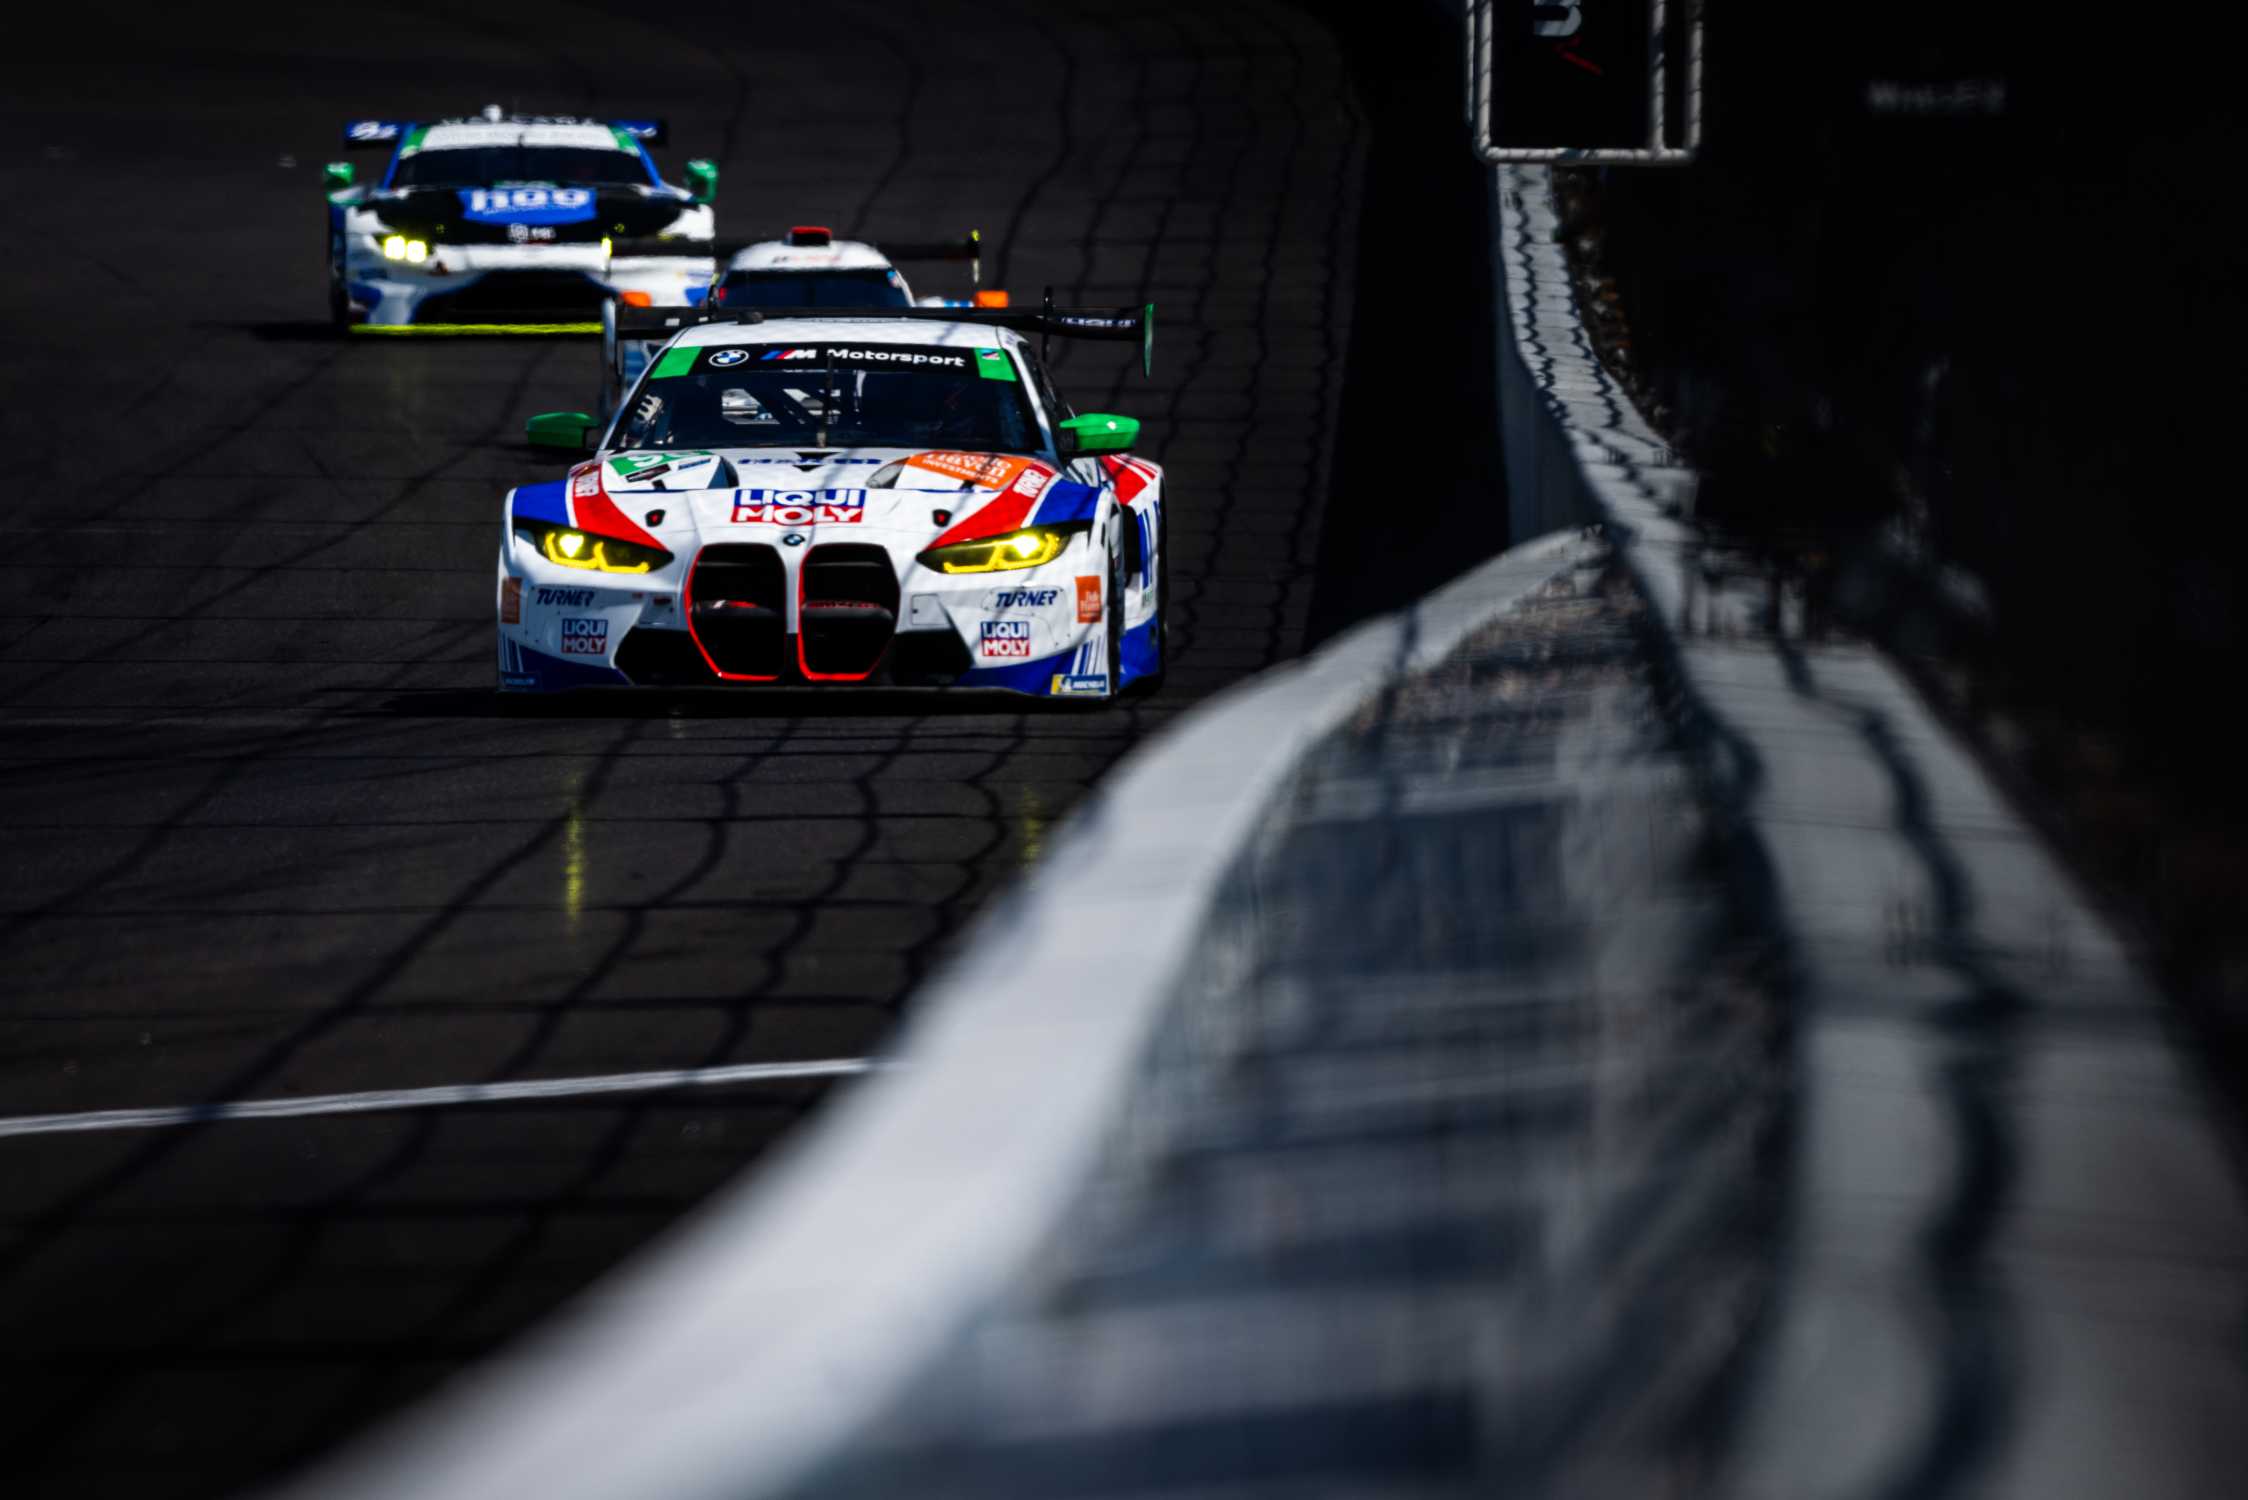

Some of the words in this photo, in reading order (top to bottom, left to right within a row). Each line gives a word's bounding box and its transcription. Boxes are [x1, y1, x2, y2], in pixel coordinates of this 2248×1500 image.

[827, 348, 966, 368] Motorsport
[739, 490, 858, 507] LIQUI
[736, 506, 862, 526] MOLY
[536, 589, 595, 607] TURNER
[995, 589, 1058, 608] TURNER
[563, 620, 606, 637] LIQUI
[983, 622, 1028, 639] LIQUI
[563, 637, 606, 653] MOLY
[984, 639, 1030, 656] MOLY
